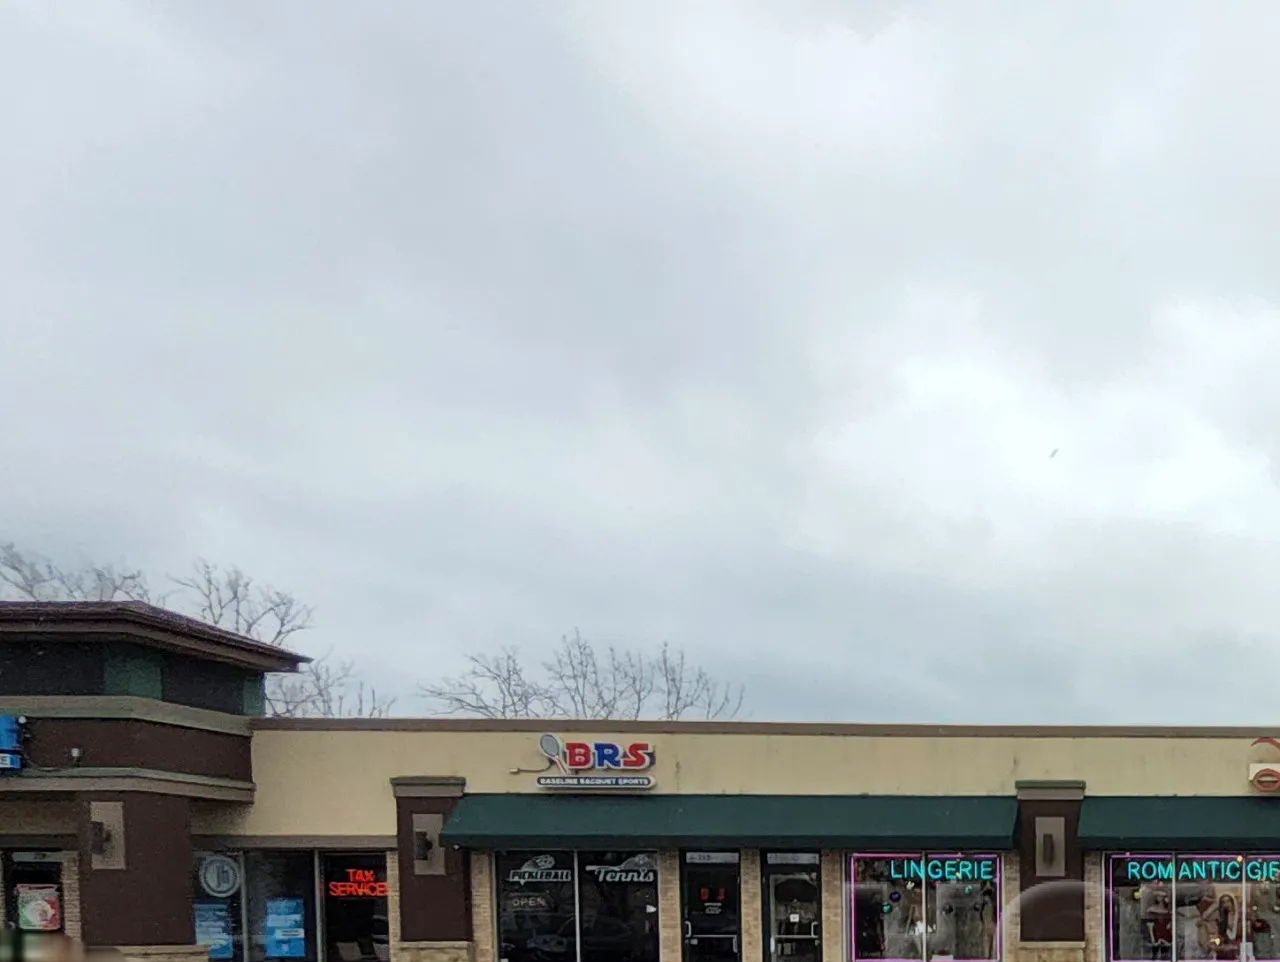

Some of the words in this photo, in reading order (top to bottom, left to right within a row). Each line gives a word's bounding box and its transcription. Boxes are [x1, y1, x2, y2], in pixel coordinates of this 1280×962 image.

[565, 742, 650, 769] BRS
[345, 869, 375, 882] TAX
[595, 867, 654, 882] Tennis
[889, 860, 994, 880] LINGERIE
[1127, 861, 1241, 880] ROMANTIC
[329, 882, 388, 896] SERVICE
[512, 897, 548, 907] OPEN
